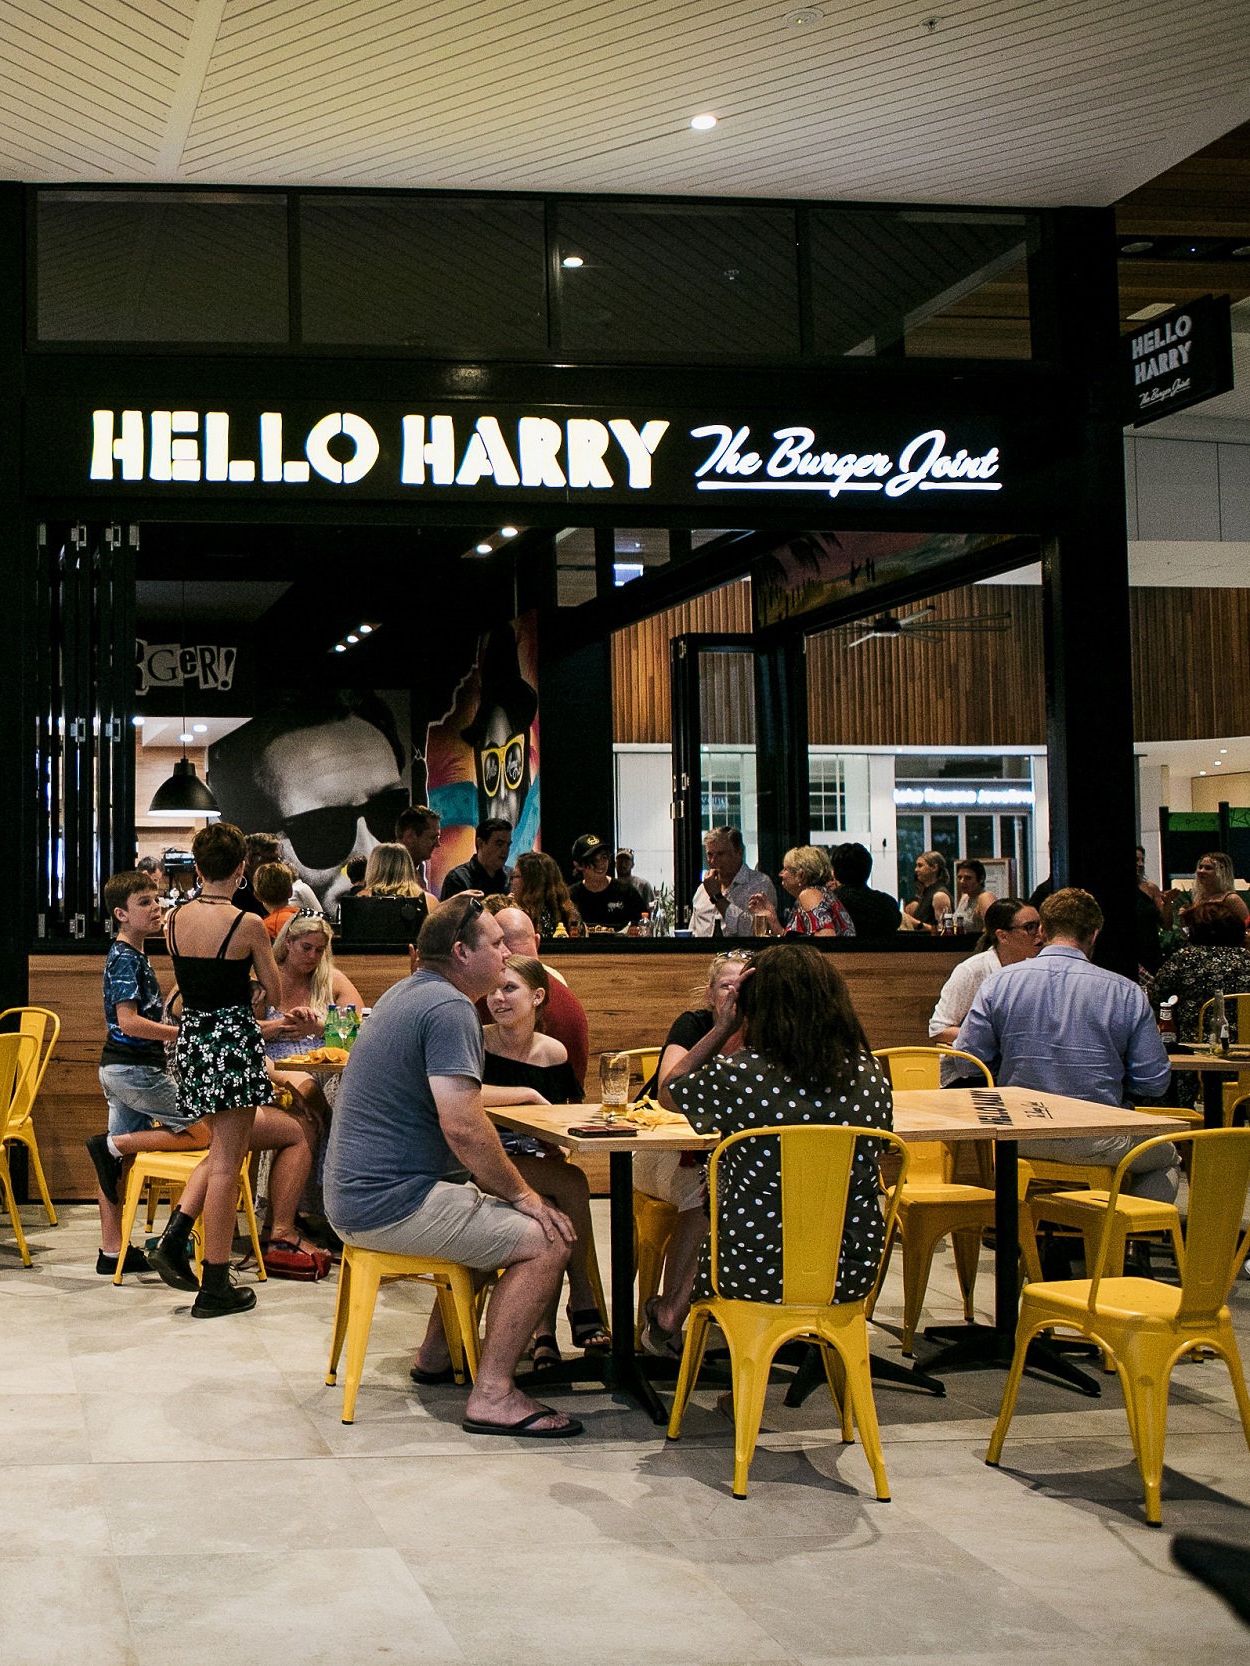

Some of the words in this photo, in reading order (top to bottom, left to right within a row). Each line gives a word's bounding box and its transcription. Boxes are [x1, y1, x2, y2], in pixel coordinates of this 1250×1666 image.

[1132, 315, 1192, 360] HELLO
[1134, 340, 1192, 386] HARRY
[89, 410, 380, 484] HELLO
[401, 415, 670, 489] HARRY
[690, 424, 762, 477] The
[767, 426, 893, 498] Burger
[885, 429, 1000, 497] Joint
